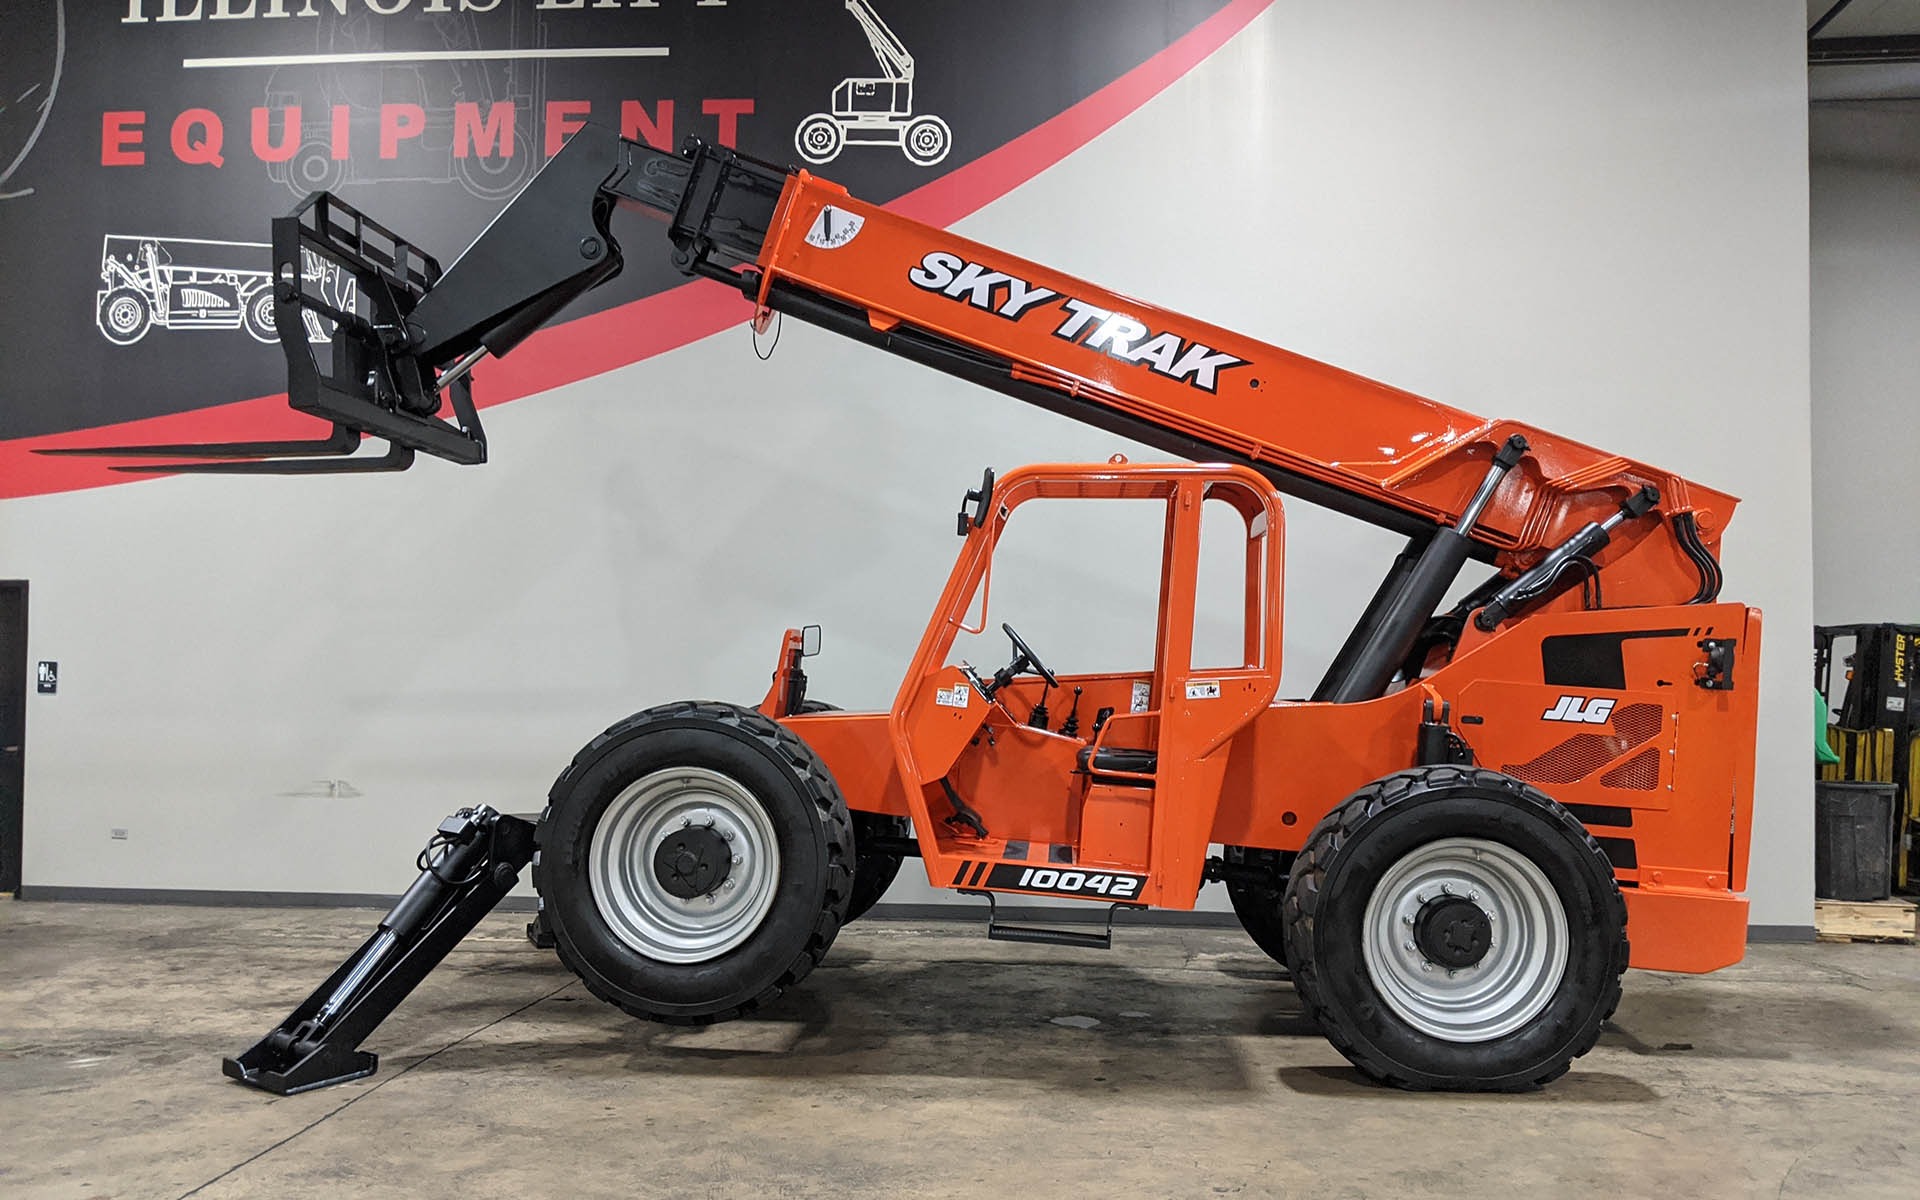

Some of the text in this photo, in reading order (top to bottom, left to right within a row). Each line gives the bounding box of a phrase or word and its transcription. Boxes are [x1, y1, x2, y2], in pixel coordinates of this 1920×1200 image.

[101, 98, 755, 168] EQUIPMENT
[908, 250, 1246, 392] SKY TRAK
[1894, 633, 1906, 682] HYSTER
[1541, 694, 1617, 724] JLG
[1018, 868, 1138, 897] 10042
